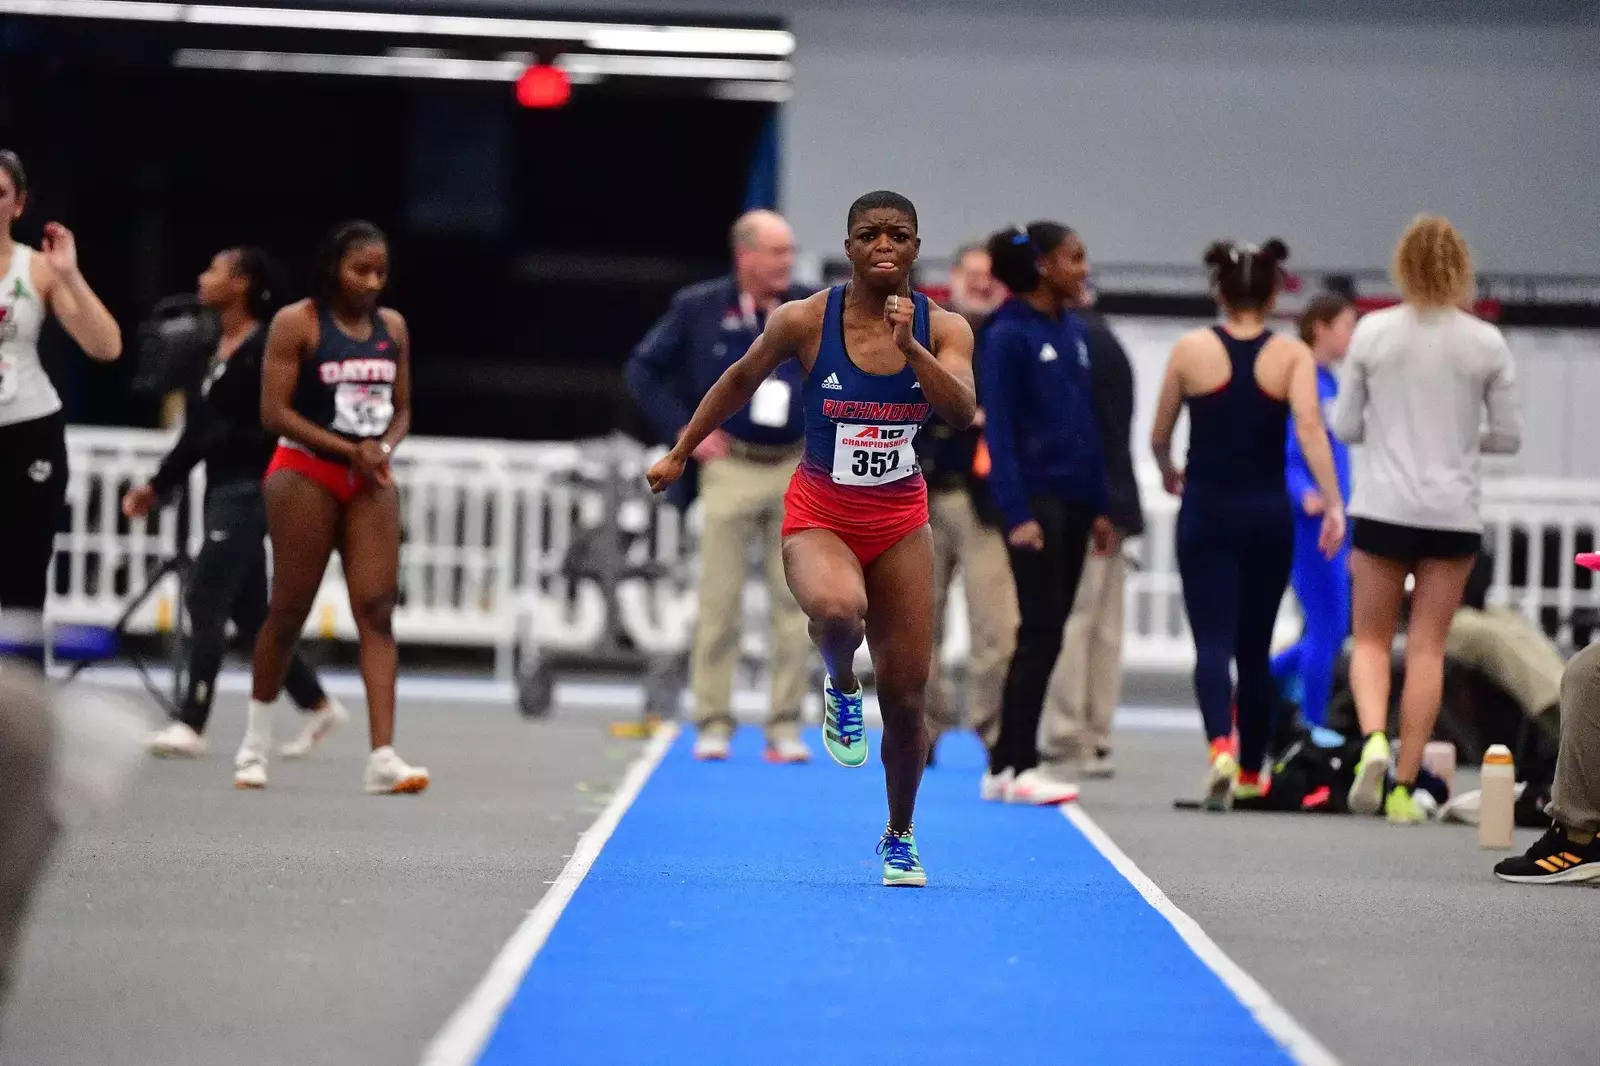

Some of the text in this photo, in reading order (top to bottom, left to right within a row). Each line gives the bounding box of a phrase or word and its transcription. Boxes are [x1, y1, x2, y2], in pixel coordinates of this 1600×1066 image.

[822, 399, 929, 421] RICHMOND
[855, 426, 905, 439] A10
[842, 438, 908, 448] CHAMPIONSHIPS
[852, 450, 900, 477] 352
